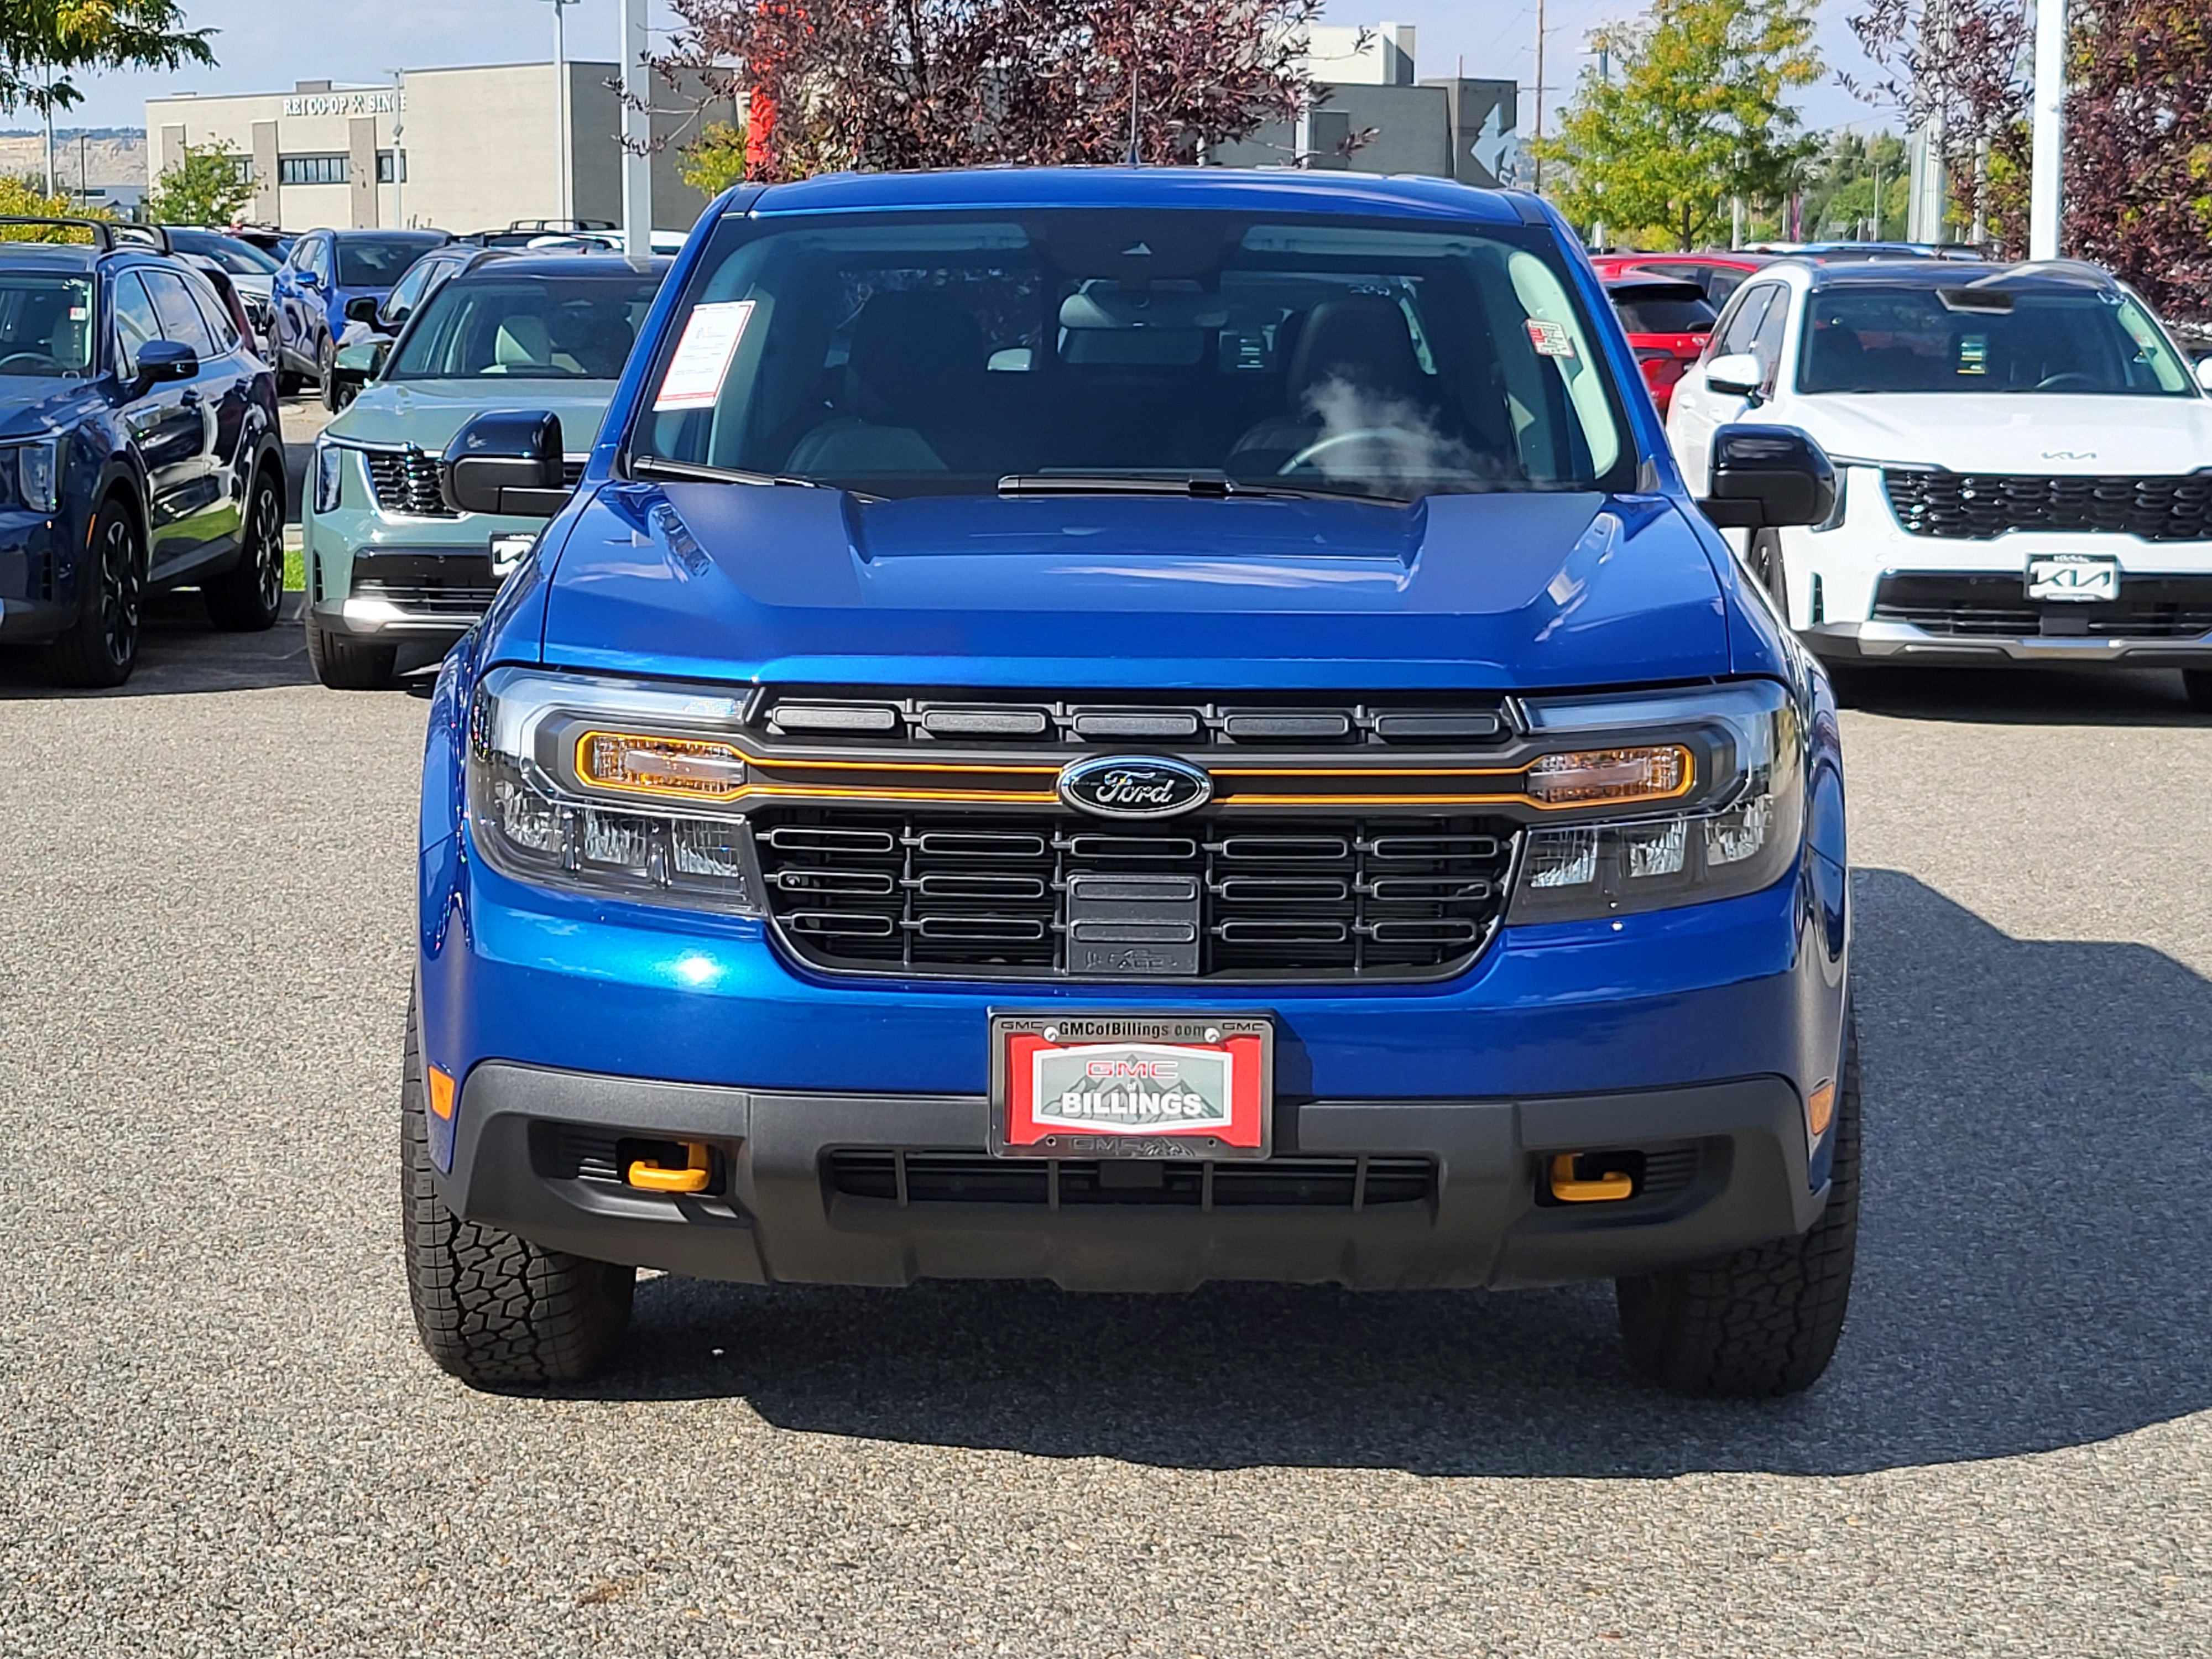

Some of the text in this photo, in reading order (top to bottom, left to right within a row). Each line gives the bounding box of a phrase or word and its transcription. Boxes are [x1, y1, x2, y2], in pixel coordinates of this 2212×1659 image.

[283, 98, 306, 115] REI
[1095, 769, 1175, 802] Ford
[1000, 1021, 1265, 1039] GMC GMCofBillingscom GMC
[1086, 1060, 1179, 1078] GMC
[1127, 1082, 1138, 1091] of
[1061, 1092, 1203, 1115] BILLINGS
